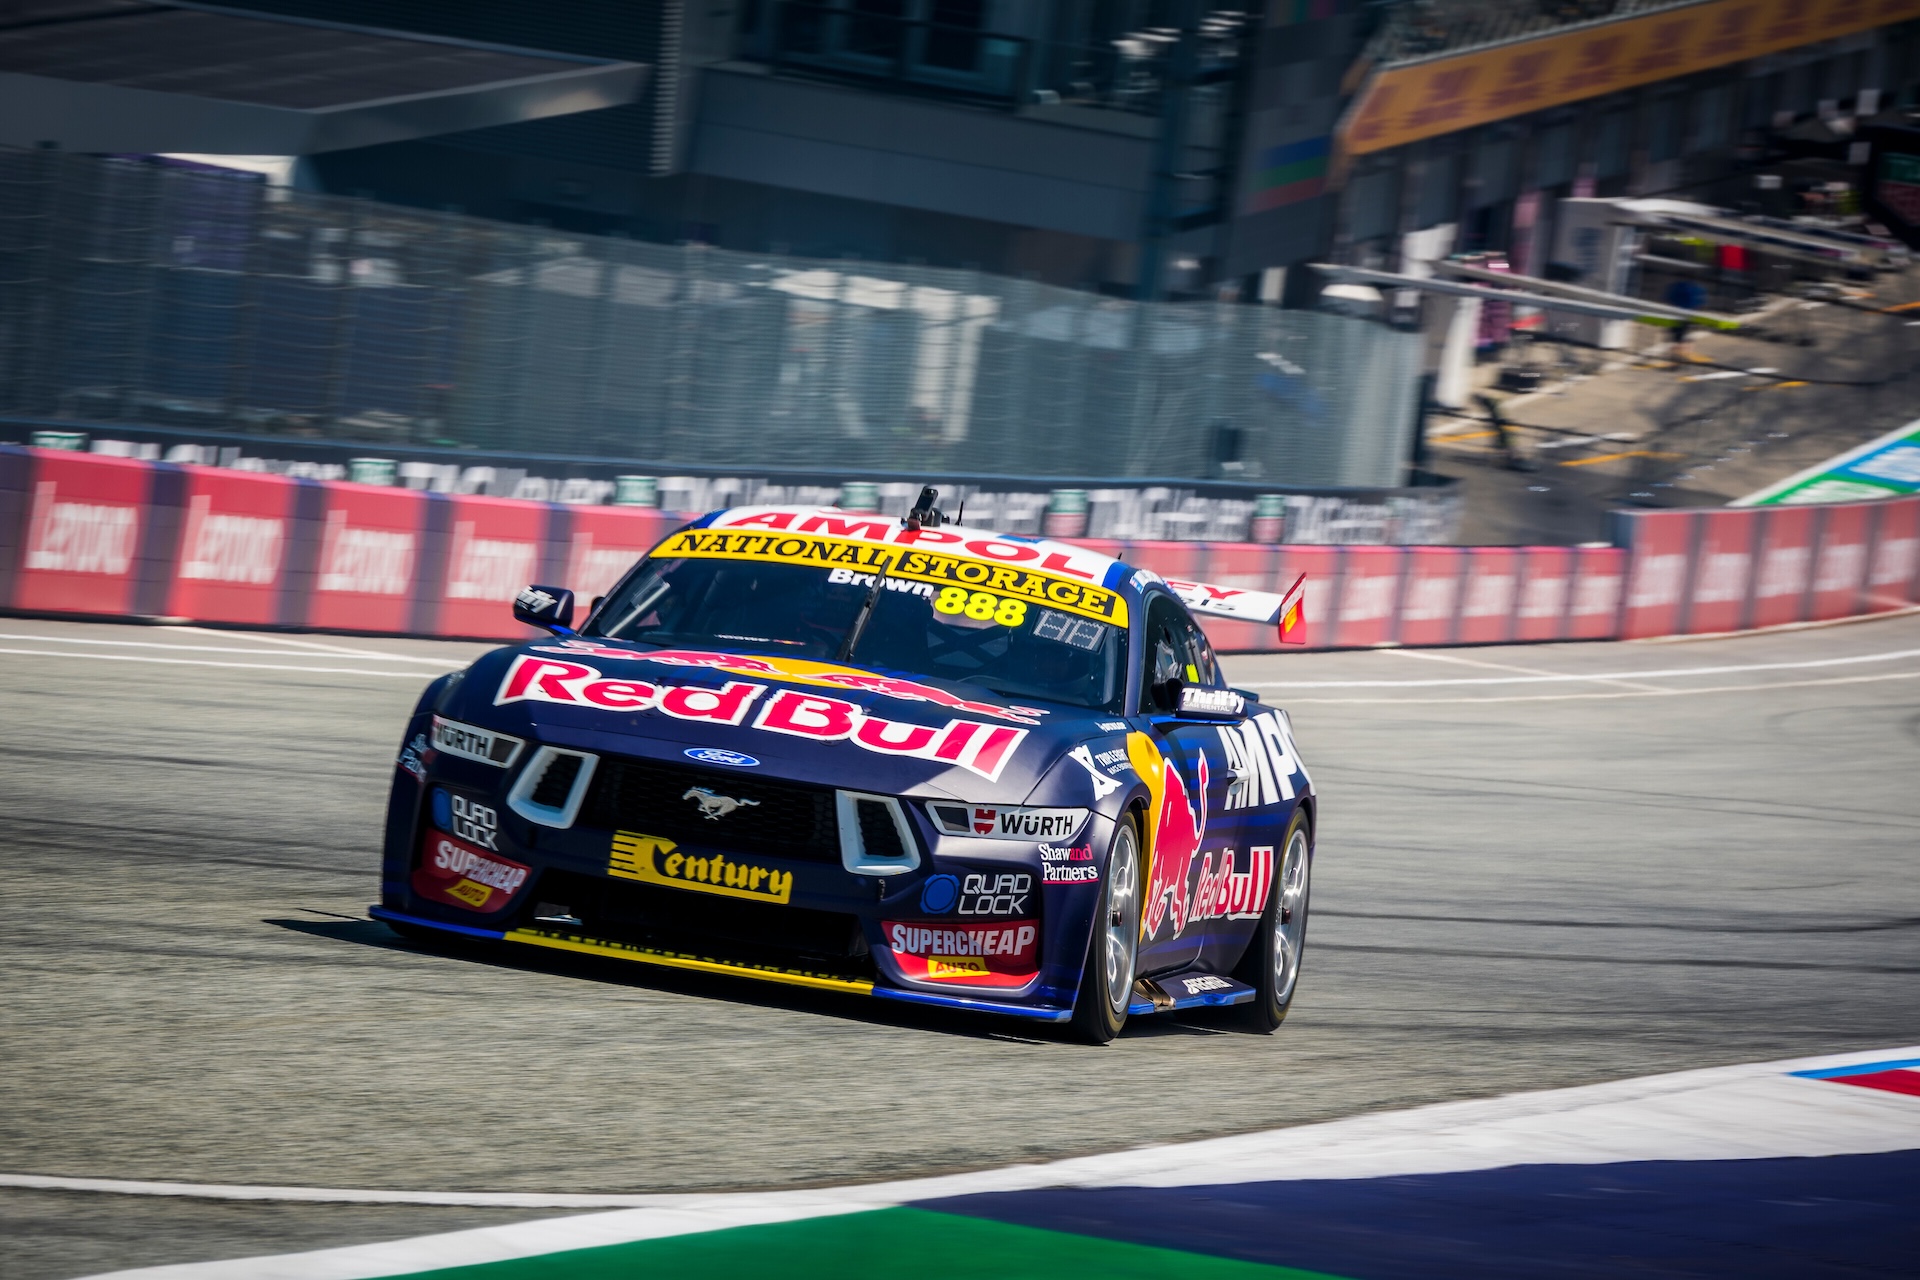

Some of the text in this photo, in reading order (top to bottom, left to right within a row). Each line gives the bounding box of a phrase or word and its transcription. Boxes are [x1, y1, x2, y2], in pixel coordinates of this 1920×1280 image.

[724, 513, 1094, 579] AMPOL
[672, 534, 886, 567] NATIONAL
[904, 553, 1109, 613] STORAGE
[828, 568, 934, 597] Brown
[934, 587, 1027, 627] 888
[1182, 687, 1245, 714] Thrifty
[493, 654, 1029, 783] Red Bull
[452, 795, 498, 830] QUAD
[1001, 813, 1073, 836] WÜRTH
[453, 815, 499, 851] LOCK
[648, 838, 794, 898] Century
[1042, 862, 1098, 882] Partners
[963, 874, 1032, 895] QUAD
[958, 895, 1028, 915] LOCK
[892, 924, 1035, 956] SUPERCHEAP
[935, 961, 981, 974] AUTO
